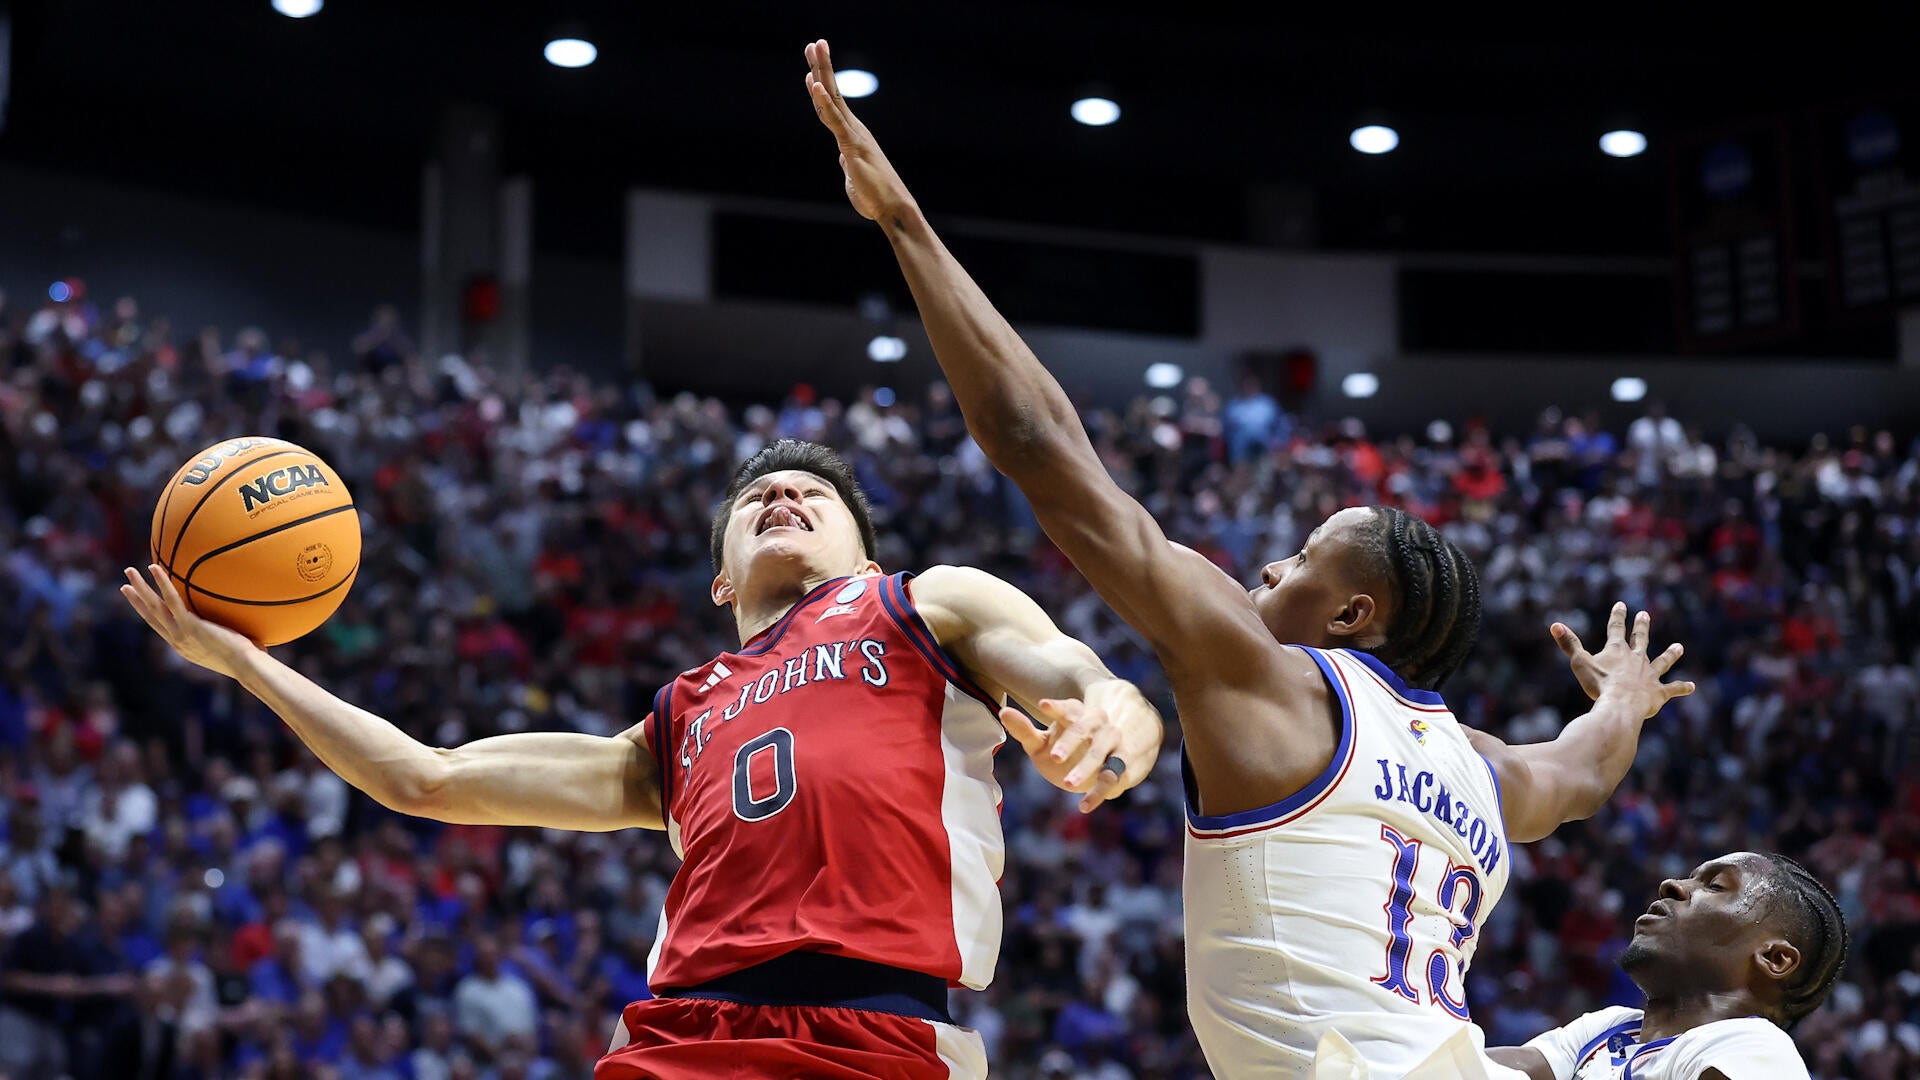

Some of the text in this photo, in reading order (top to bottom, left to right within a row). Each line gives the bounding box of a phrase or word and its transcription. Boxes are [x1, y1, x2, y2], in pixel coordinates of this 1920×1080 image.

[237, 464, 329, 513] NCAA
[249, 499, 288, 520] OFFICIAL
[289, 491, 314, 502] GAME
[722, 639, 889, 722] JOHN'S
[732, 726, 798, 823] 0
[1375, 759, 1501, 878] JACKSON
[1370, 823, 1485, 1022] 13
